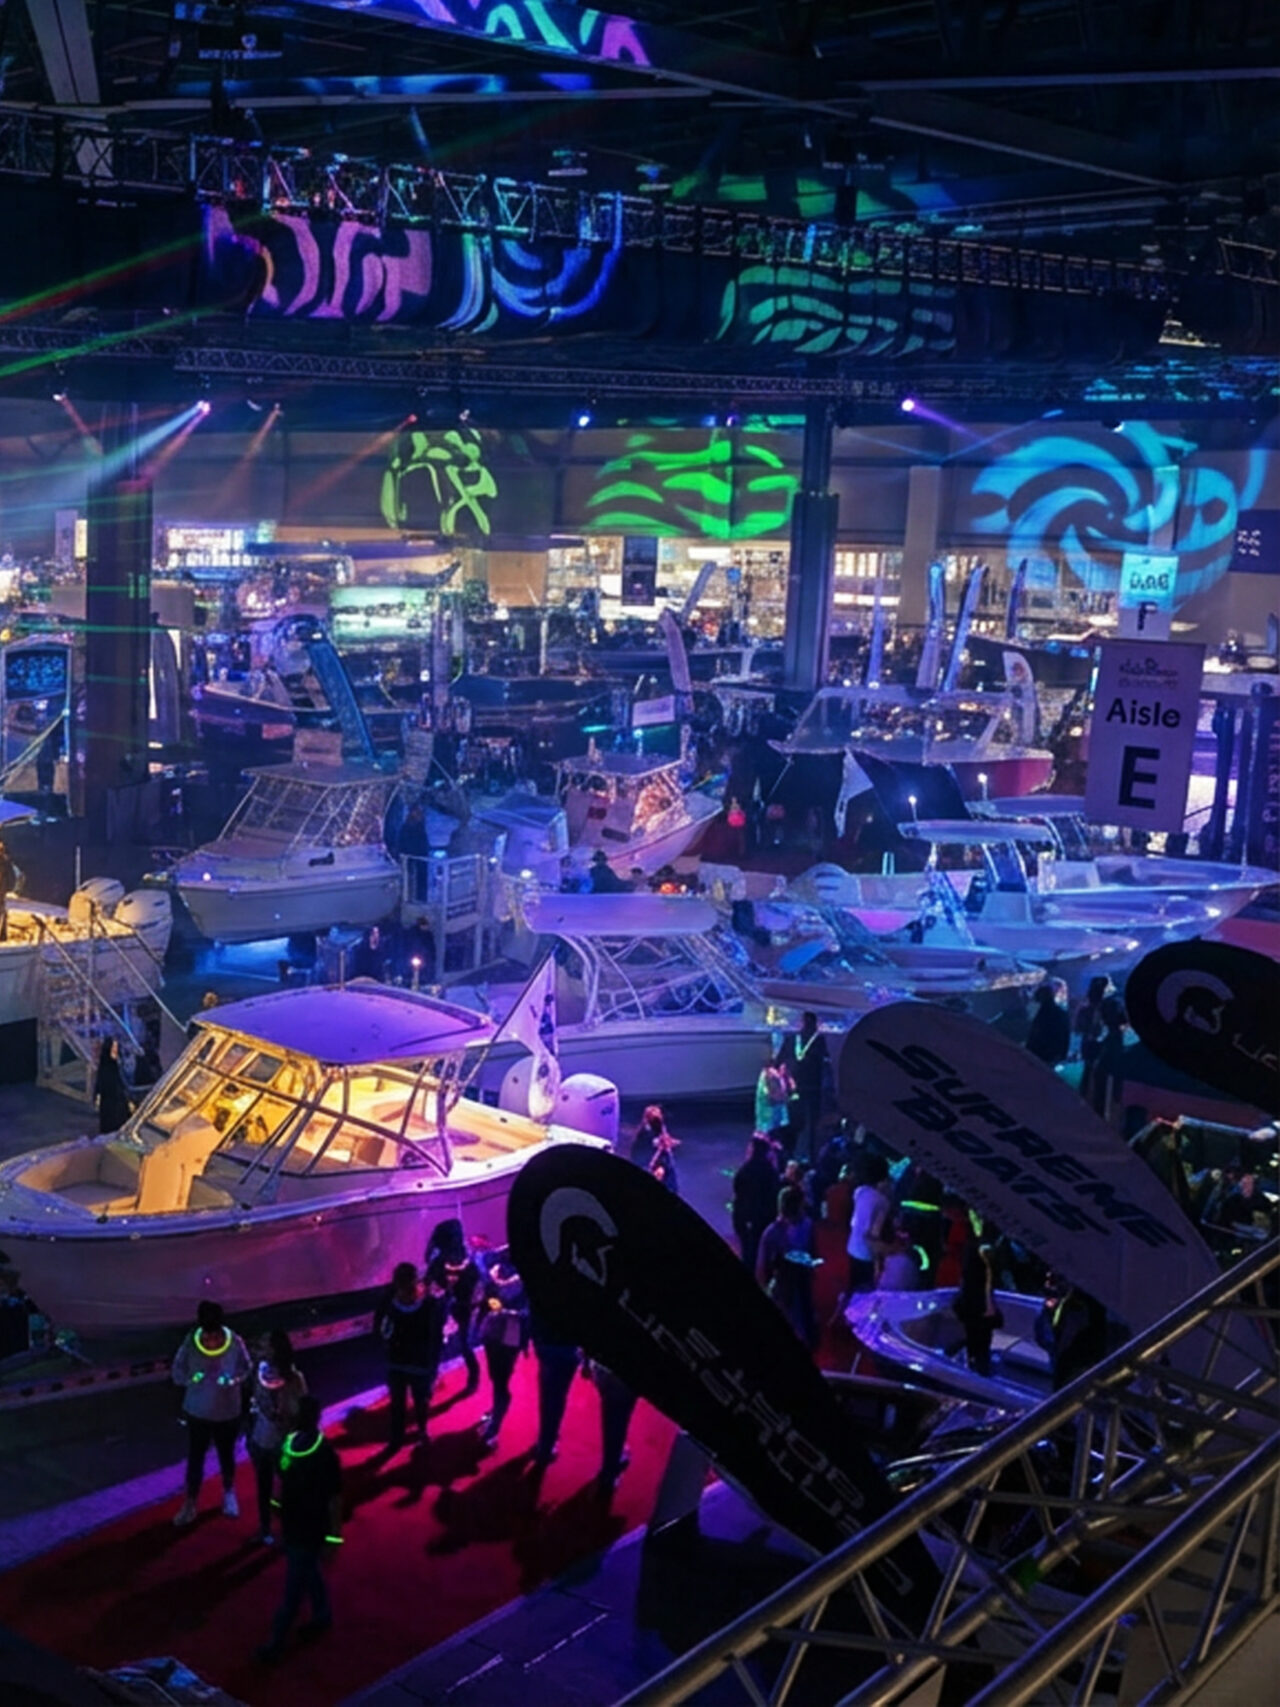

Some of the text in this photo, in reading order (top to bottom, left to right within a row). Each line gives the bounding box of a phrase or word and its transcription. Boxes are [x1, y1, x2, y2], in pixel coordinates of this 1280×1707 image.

[1106, 698, 1180, 728] Aisle
[1118, 745, 1160, 809] E
[866, 1038, 1186, 1246] SUPREME
[892, 1085, 1111, 1236] BOATS
